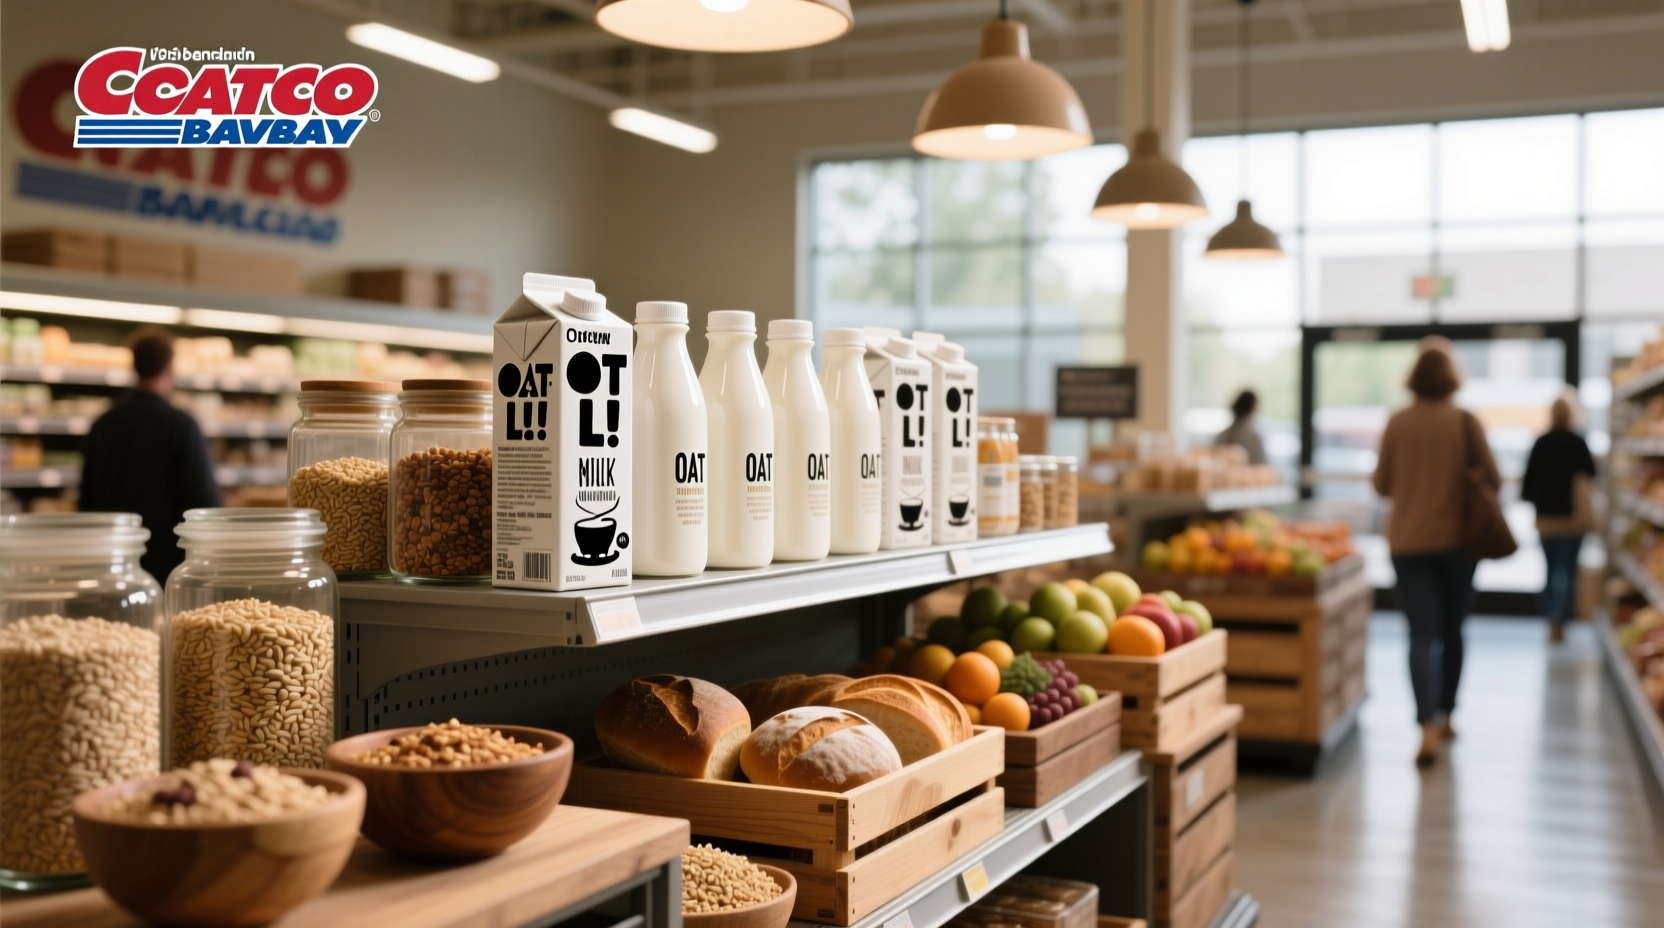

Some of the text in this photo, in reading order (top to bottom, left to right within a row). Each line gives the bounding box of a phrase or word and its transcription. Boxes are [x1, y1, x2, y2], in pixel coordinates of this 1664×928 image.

[566, 351, 627, 396] OT
[896, 383, 929, 411] OT
[946, 387, 974, 413] OT
[506, 401, 548, 441] L!!
[579, 398, 620, 448] L!
[903, 415, 925, 447] L!
[675, 452, 706, 483] OAT
[746, 453, 773, 482] OAT
[807, 453, 830, 481] OAT
[861, 453, 880, 479] OAT
